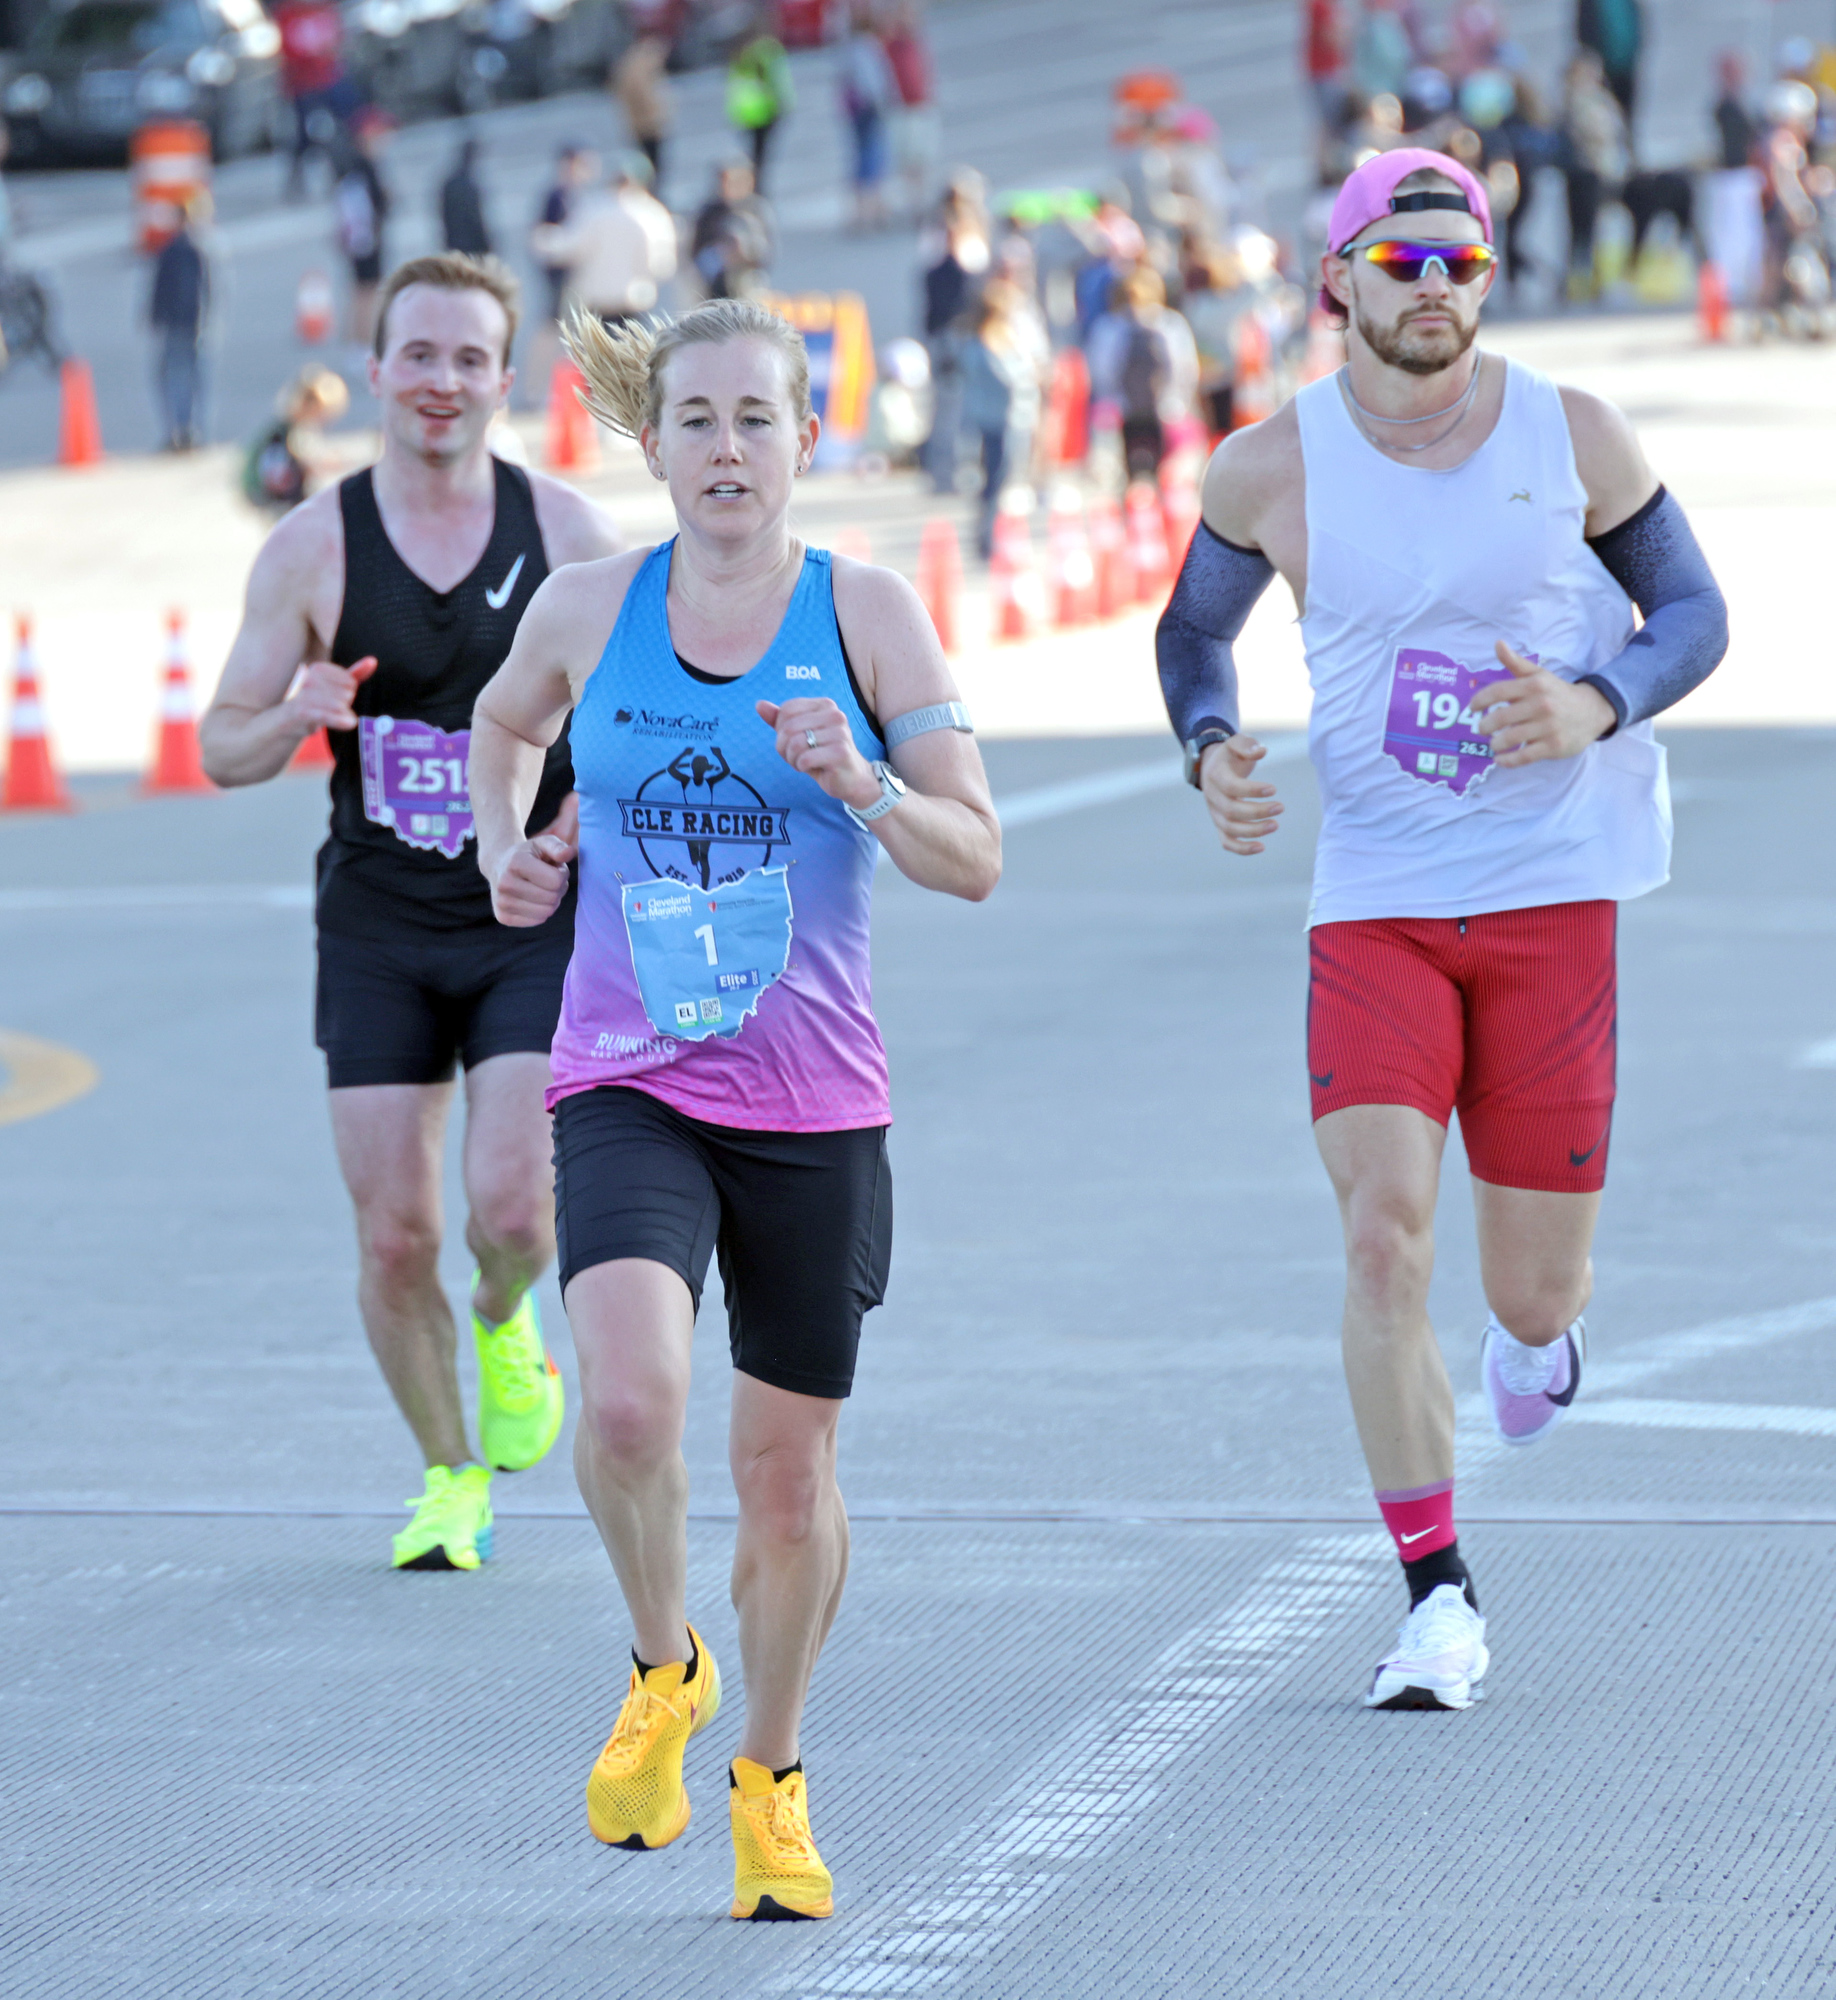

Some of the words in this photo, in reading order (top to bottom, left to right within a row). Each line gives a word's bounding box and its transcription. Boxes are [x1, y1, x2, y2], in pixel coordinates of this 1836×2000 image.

[398, 757, 471, 794] 251
[632, 809, 672, 833] CLE
[682, 813, 774, 837] RACING
[648, 894, 691, 908] Cleveland
[648, 904, 692, 917] Marathon
[694, 924, 719, 967] 1
[720, 973, 748, 988] Elite
[679, 1006, 694, 1018] EL
[595, 1032, 677, 1055] RUNNING
